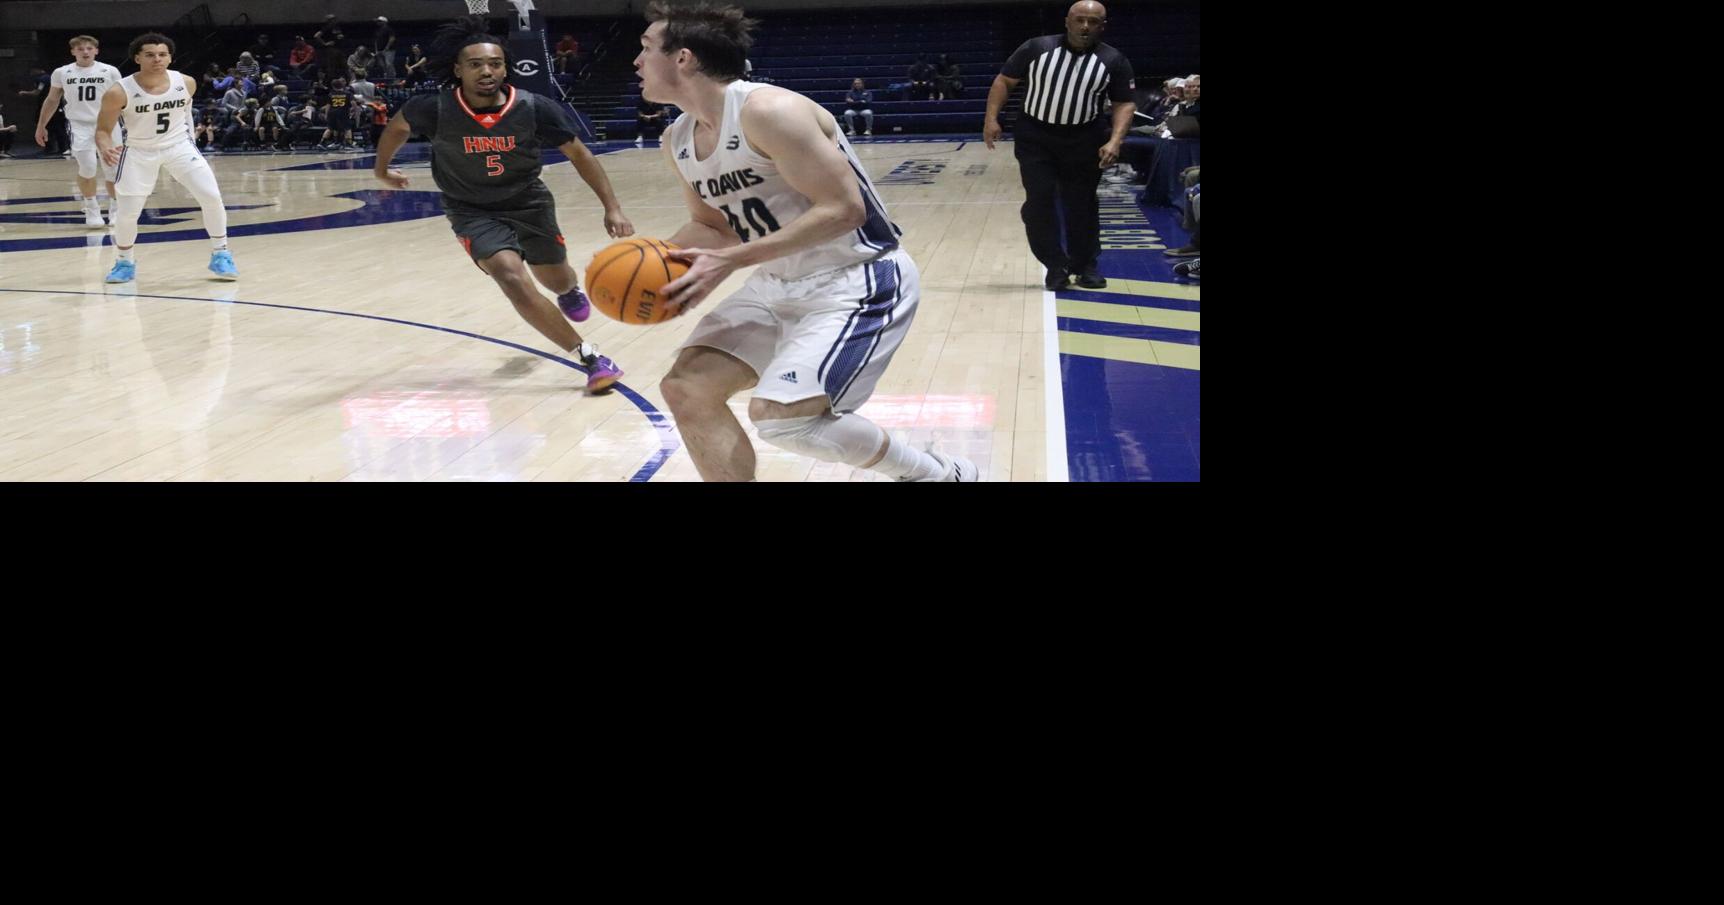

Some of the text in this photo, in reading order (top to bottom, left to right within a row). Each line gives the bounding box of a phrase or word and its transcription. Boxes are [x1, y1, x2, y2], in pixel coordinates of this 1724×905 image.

[78, 85, 96, 102] 10
[134, 99, 186, 113] UC DAVIS
[156, 112, 170, 135] 5
[462, 136, 516, 153] HNU
[486, 154, 505, 177] 5
[706, 167, 765, 197] DAVIS
